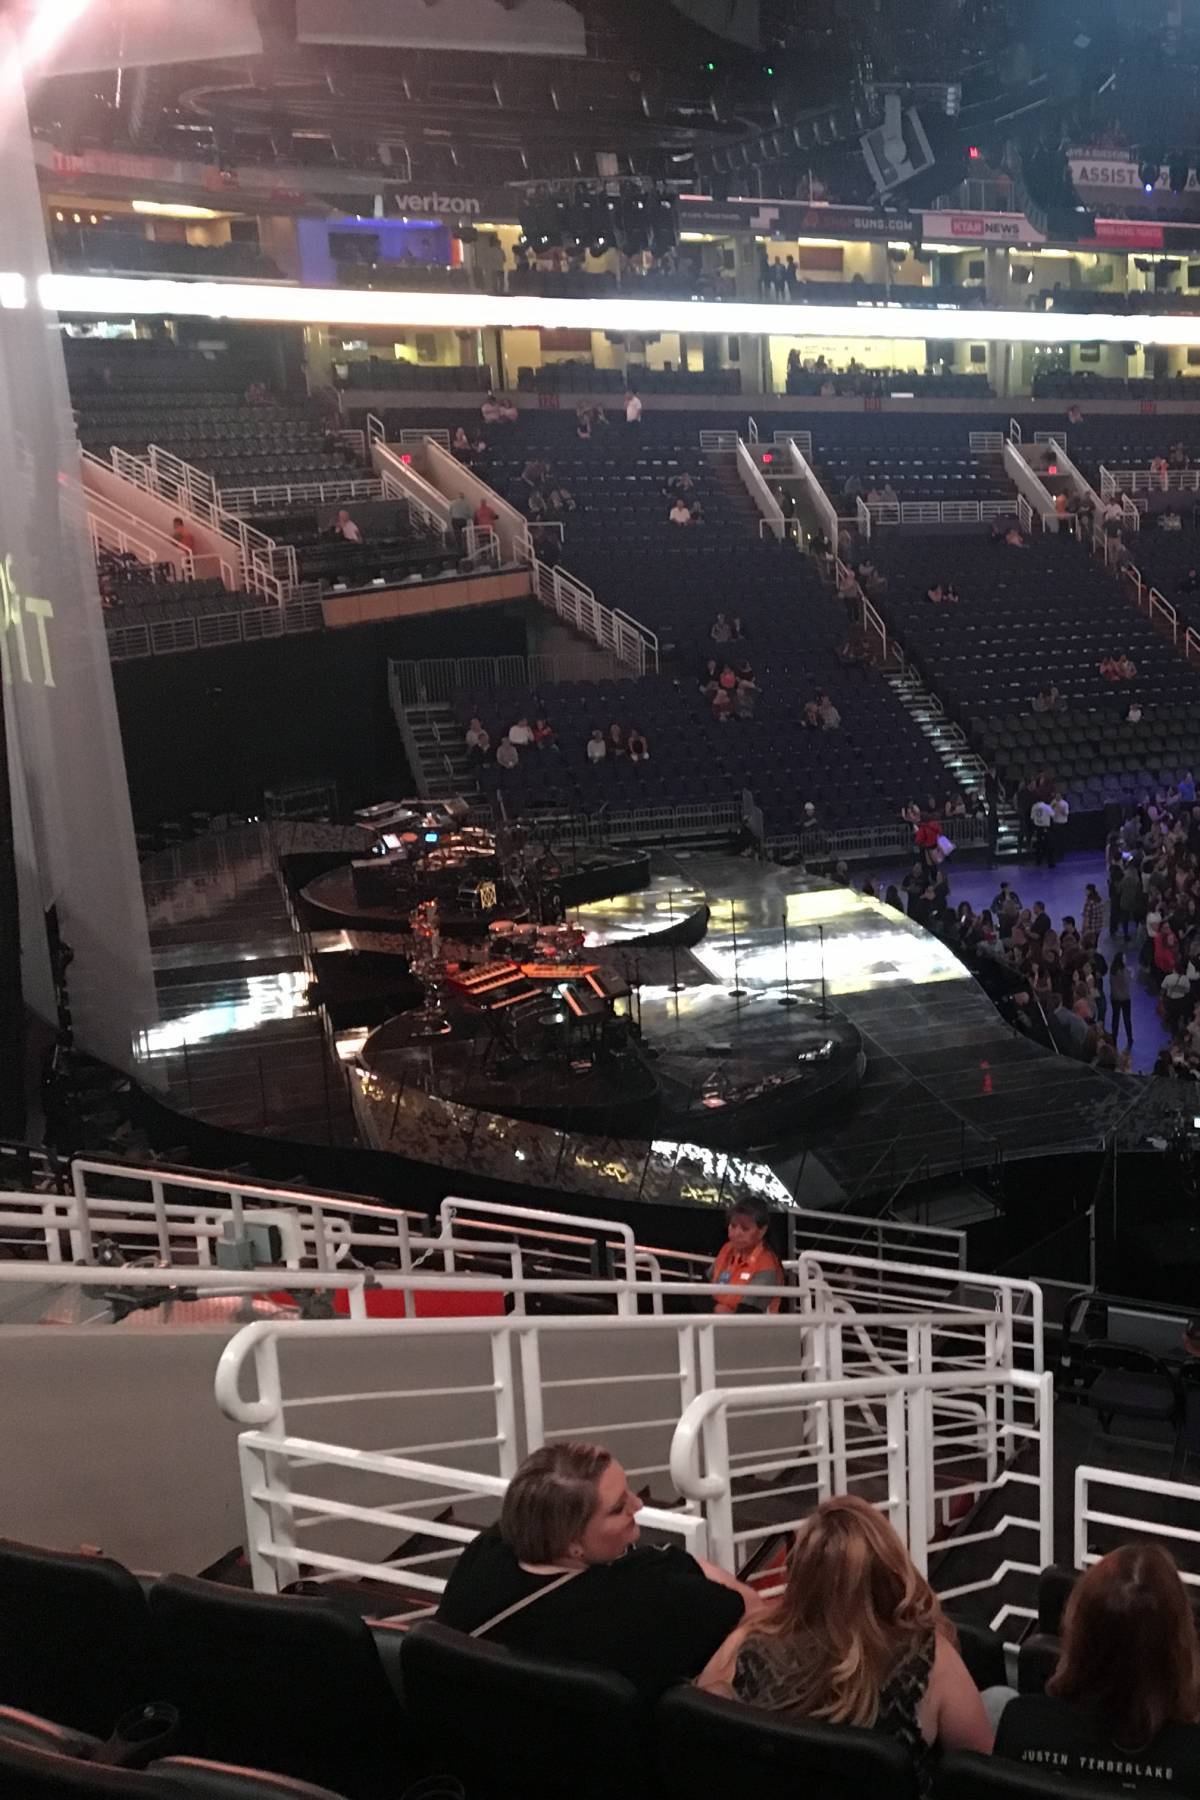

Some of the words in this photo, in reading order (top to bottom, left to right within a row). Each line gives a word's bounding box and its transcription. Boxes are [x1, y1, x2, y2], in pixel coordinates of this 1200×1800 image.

[1080, 165, 1136, 185] ASSIST
[395, 191, 481, 214] verizon
[985, 222, 1020, 234] NEWS
[1021, 1749, 1068, 1766] JUSTIN
[1079, 1755, 1174, 1780] TIMBERLAKE
